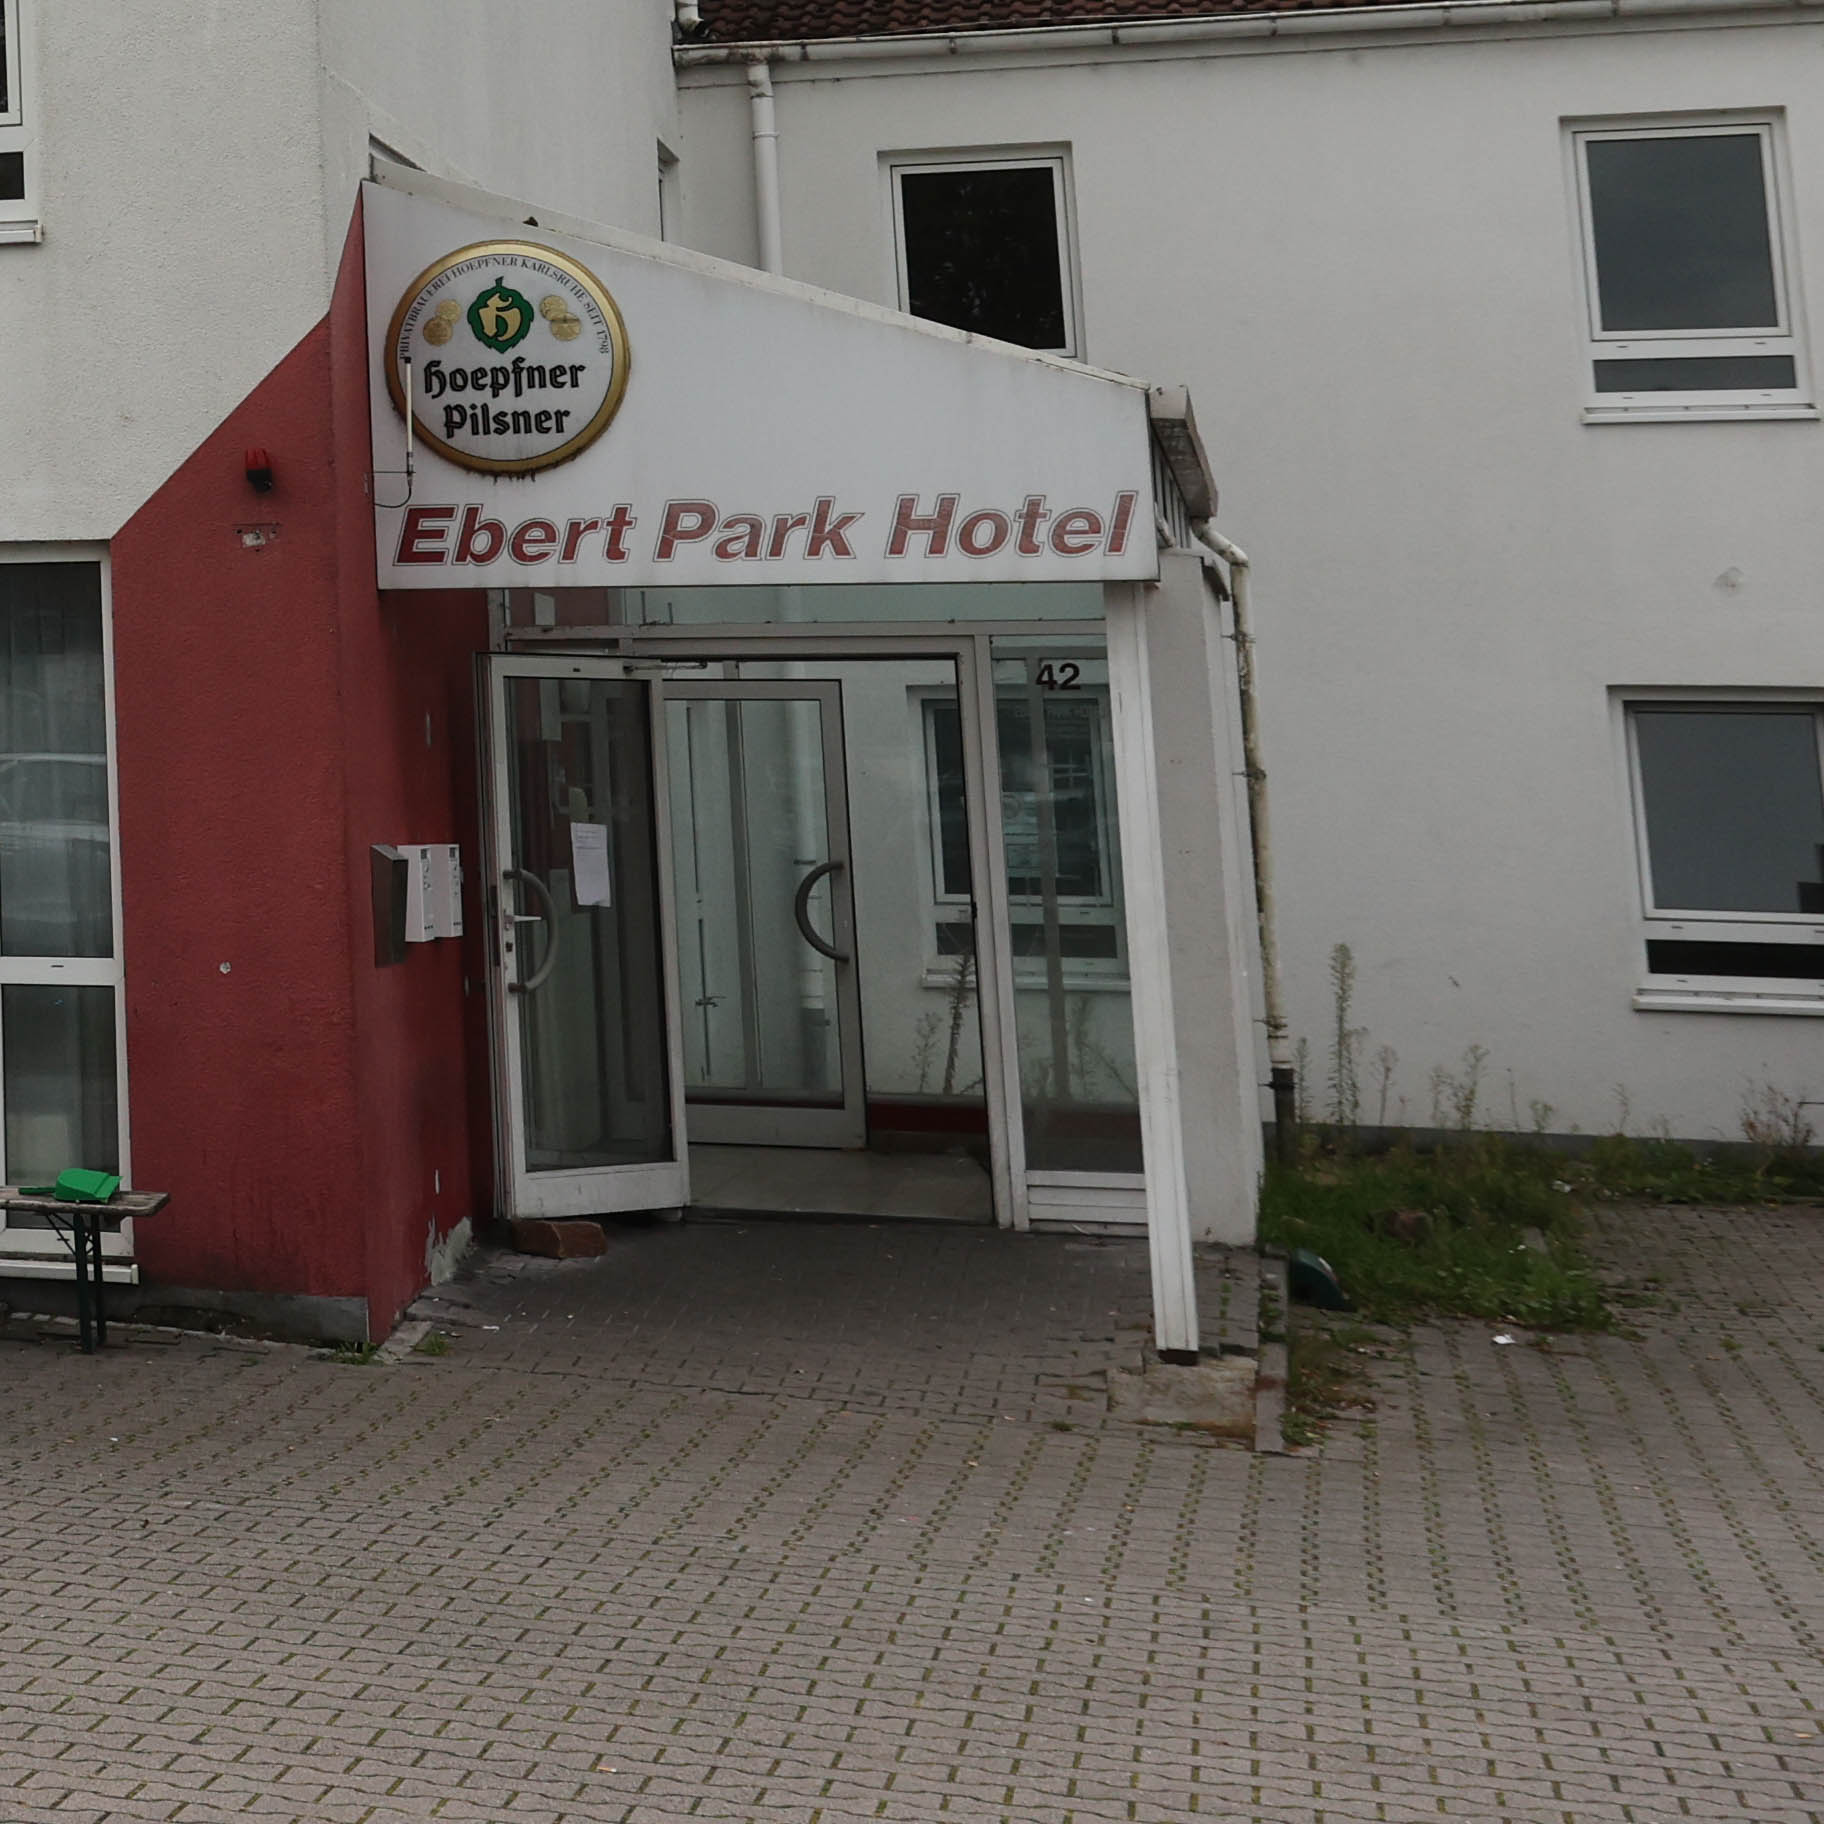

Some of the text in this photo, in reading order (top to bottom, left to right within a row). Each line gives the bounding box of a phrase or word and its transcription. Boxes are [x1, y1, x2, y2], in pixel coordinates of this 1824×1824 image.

[399, 256, 610, 360] PRIVATBRAUEREI HOEPFNER KARLSRUHE SEIT 1798
[443, 402, 570, 439] Pilsner
[393, 490, 1139, 567] Ebert Park Hotel
[1035, 662, 1081, 691] 42
